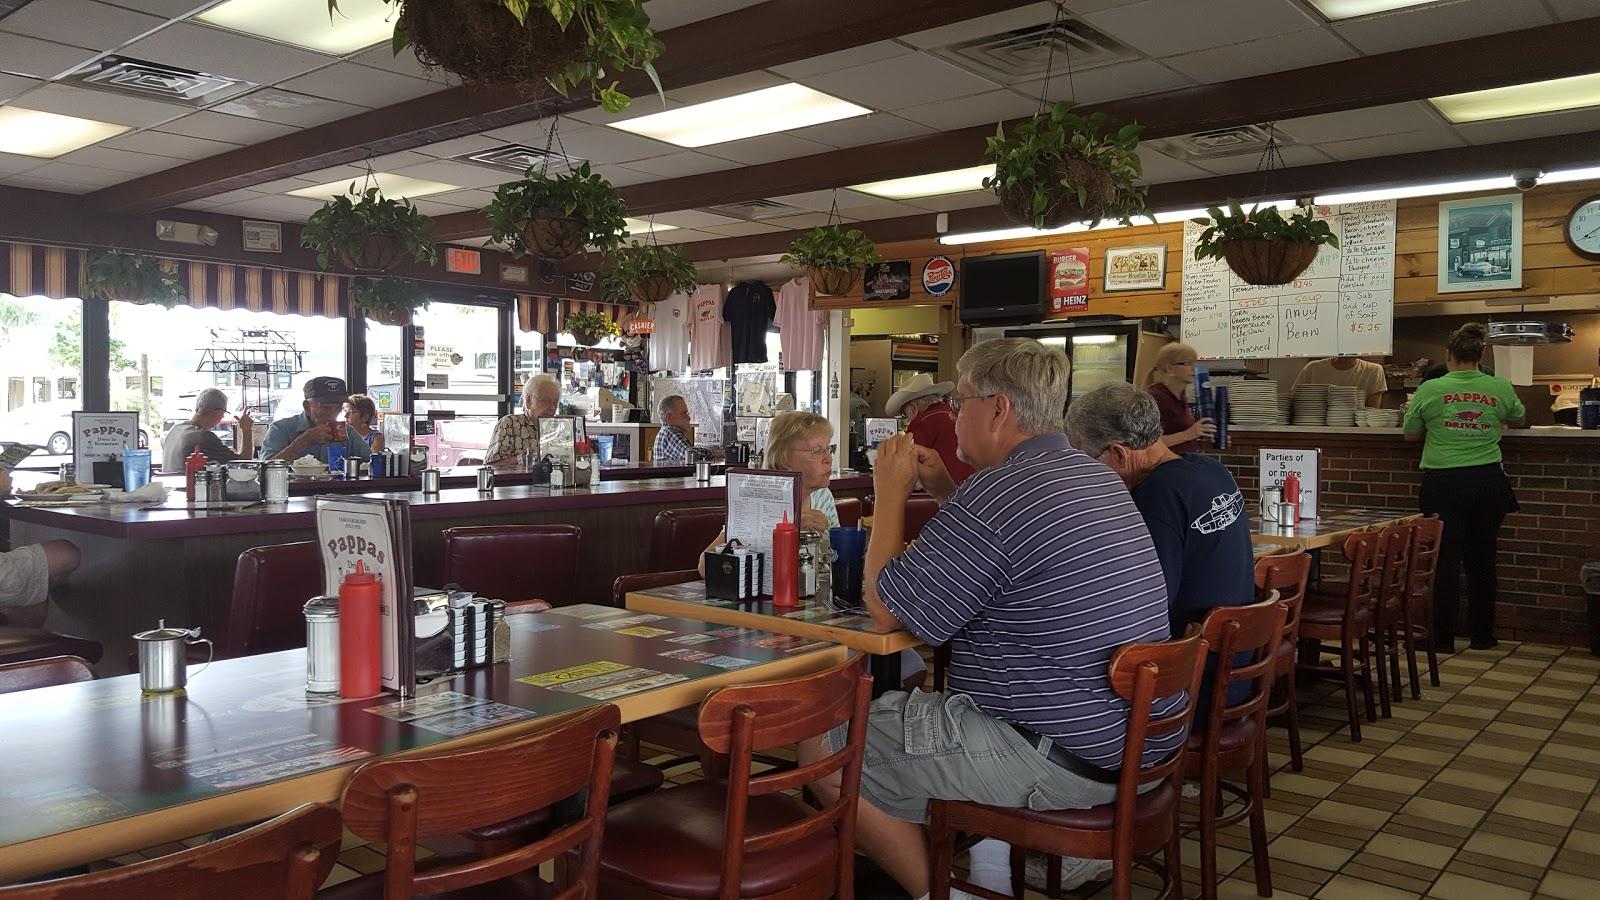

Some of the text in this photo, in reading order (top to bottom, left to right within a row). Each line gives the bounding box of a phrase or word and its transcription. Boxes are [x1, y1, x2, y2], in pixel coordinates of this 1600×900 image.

[1063, 295, 1087, 306] HEINZ
[1443, 392, 1497, 408] PAPPAS
[82, 426, 130, 438] Pappas
[1266, 453, 1304, 462] Parties of
[327, 535, 385, 565] Pappas
